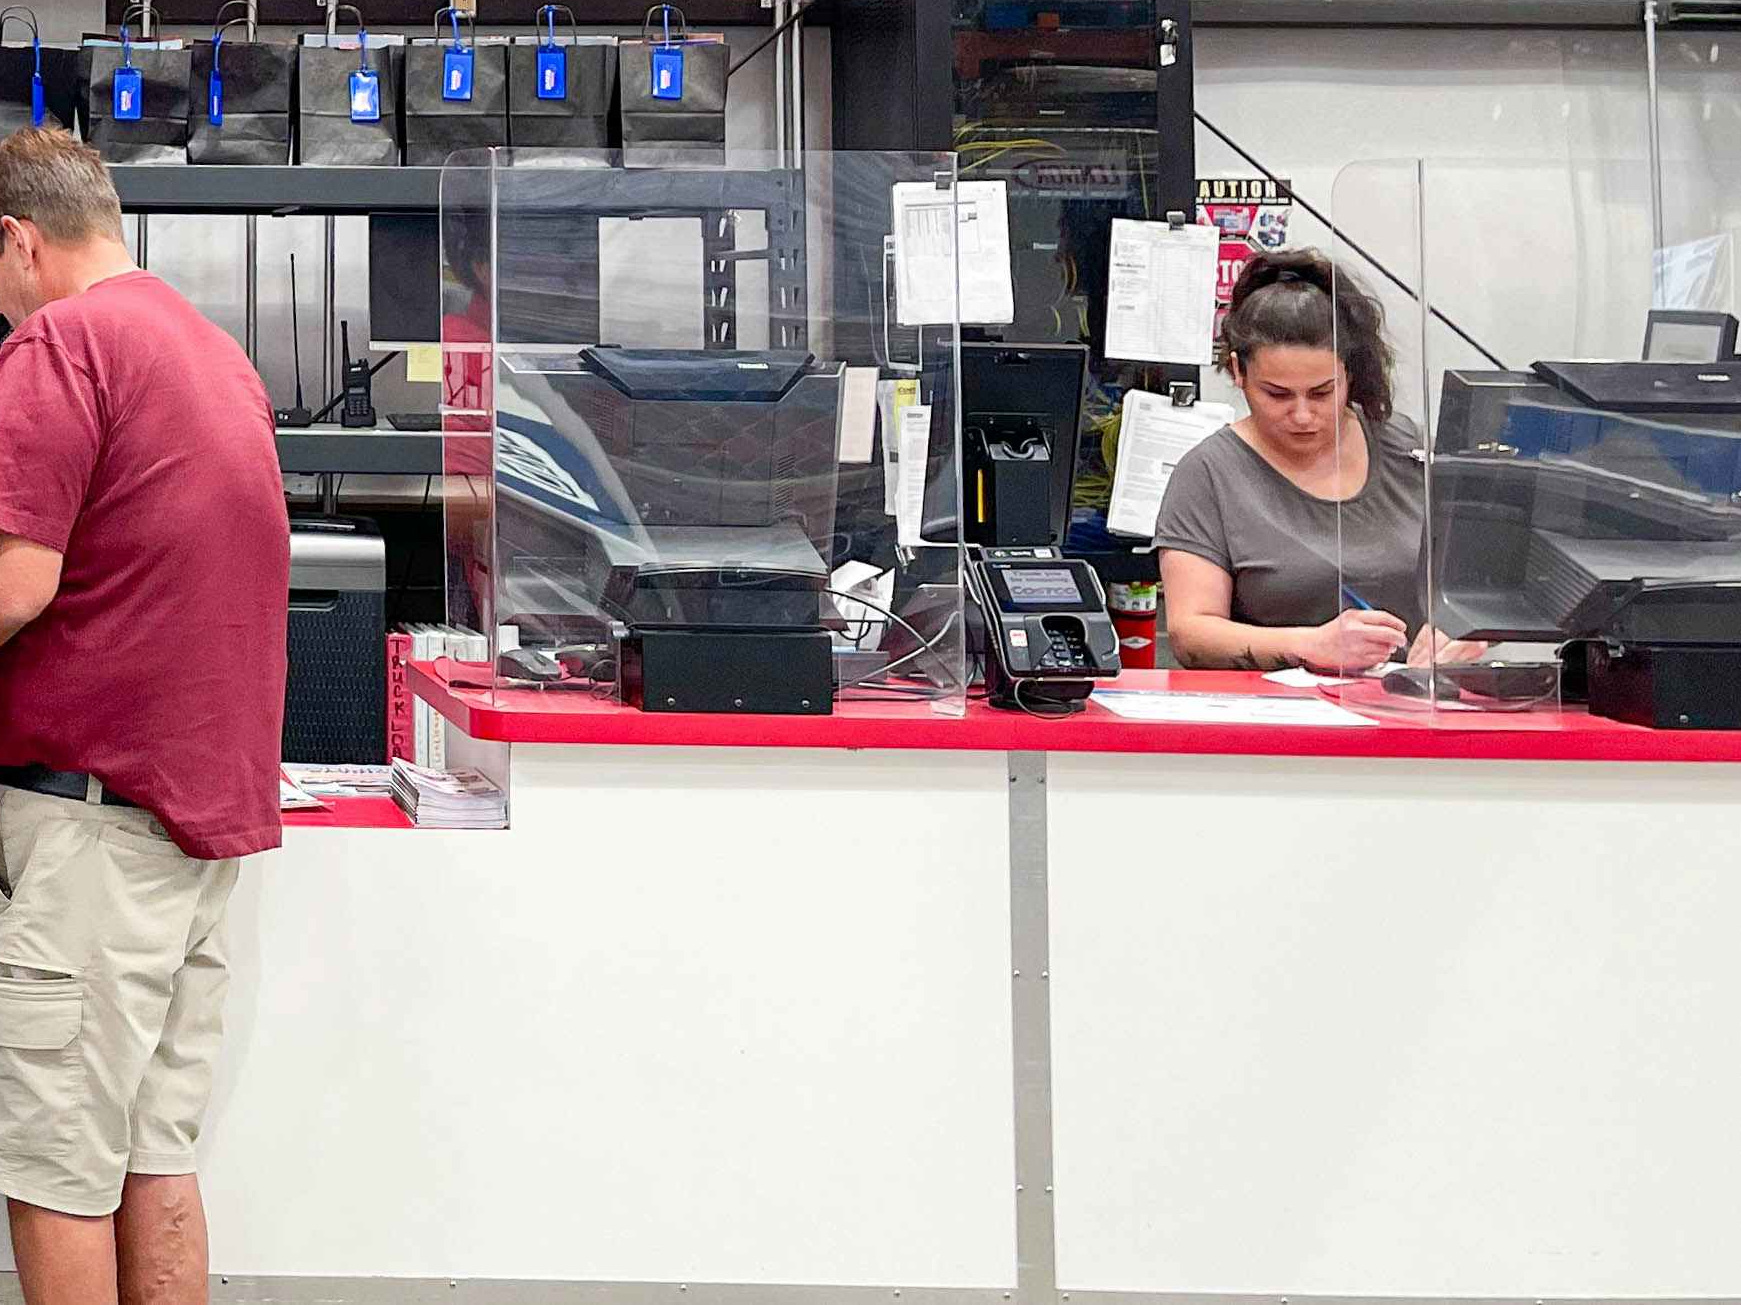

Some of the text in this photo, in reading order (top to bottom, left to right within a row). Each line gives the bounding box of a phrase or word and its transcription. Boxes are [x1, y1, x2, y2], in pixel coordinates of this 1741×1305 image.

[1198, 179, 1277, 199] AUTION
[389, 639, 407, 759] TRUCK LOA
